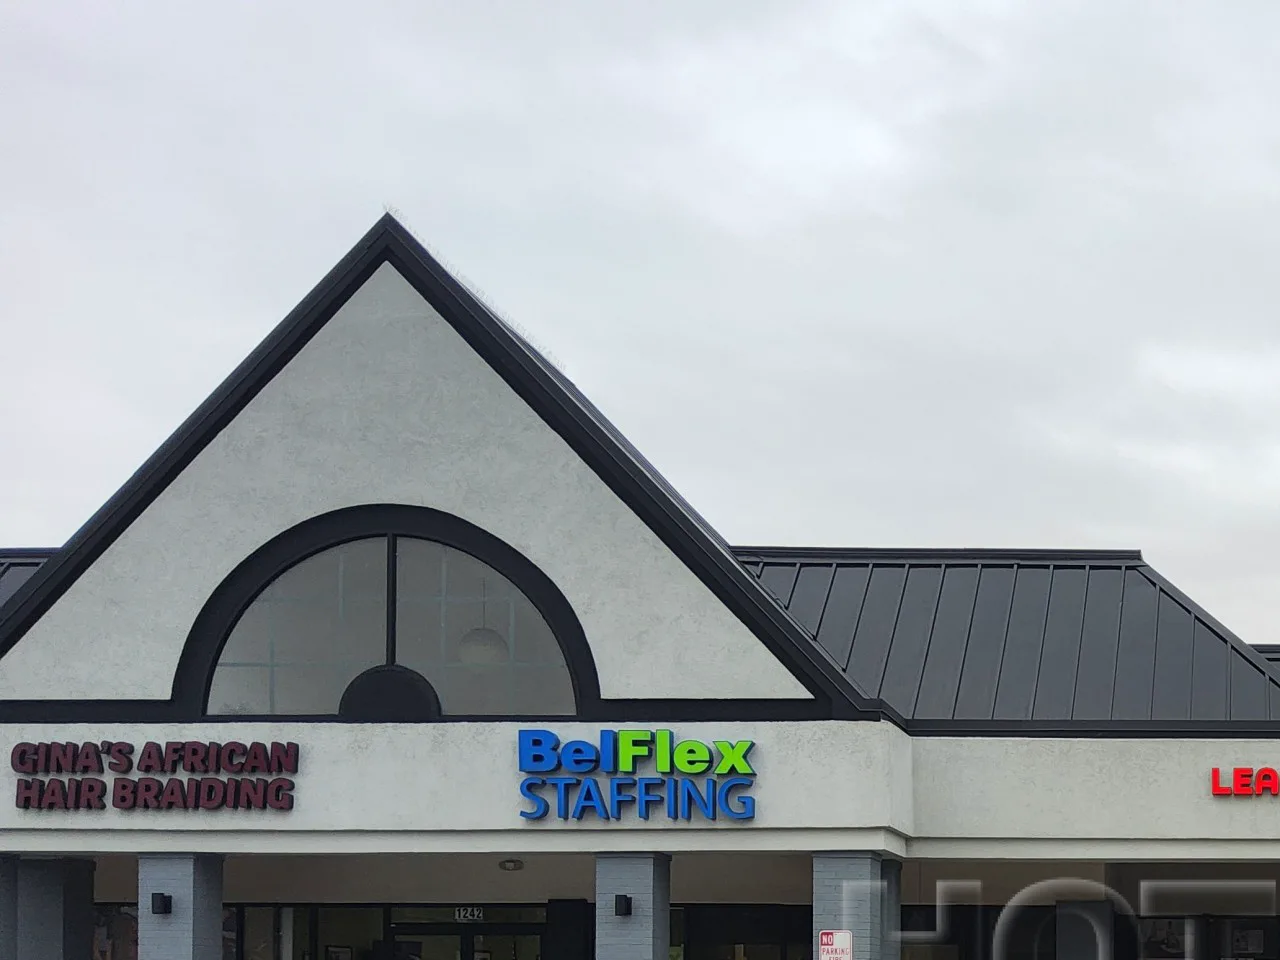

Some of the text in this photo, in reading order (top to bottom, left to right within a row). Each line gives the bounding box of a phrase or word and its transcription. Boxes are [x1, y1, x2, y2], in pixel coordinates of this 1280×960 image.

[11, 741, 300, 774] GINA'S AFRICAN
[518, 729, 757, 775] BelFlex
[16, 777, 296, 811] HAIR BRAIDING
[519, 777, 756, 821] STAFFING
[457, 908, 482, 918] 1242
[821, 934, 833, 945] NO
[822, 948, 850, 956] PARKING
